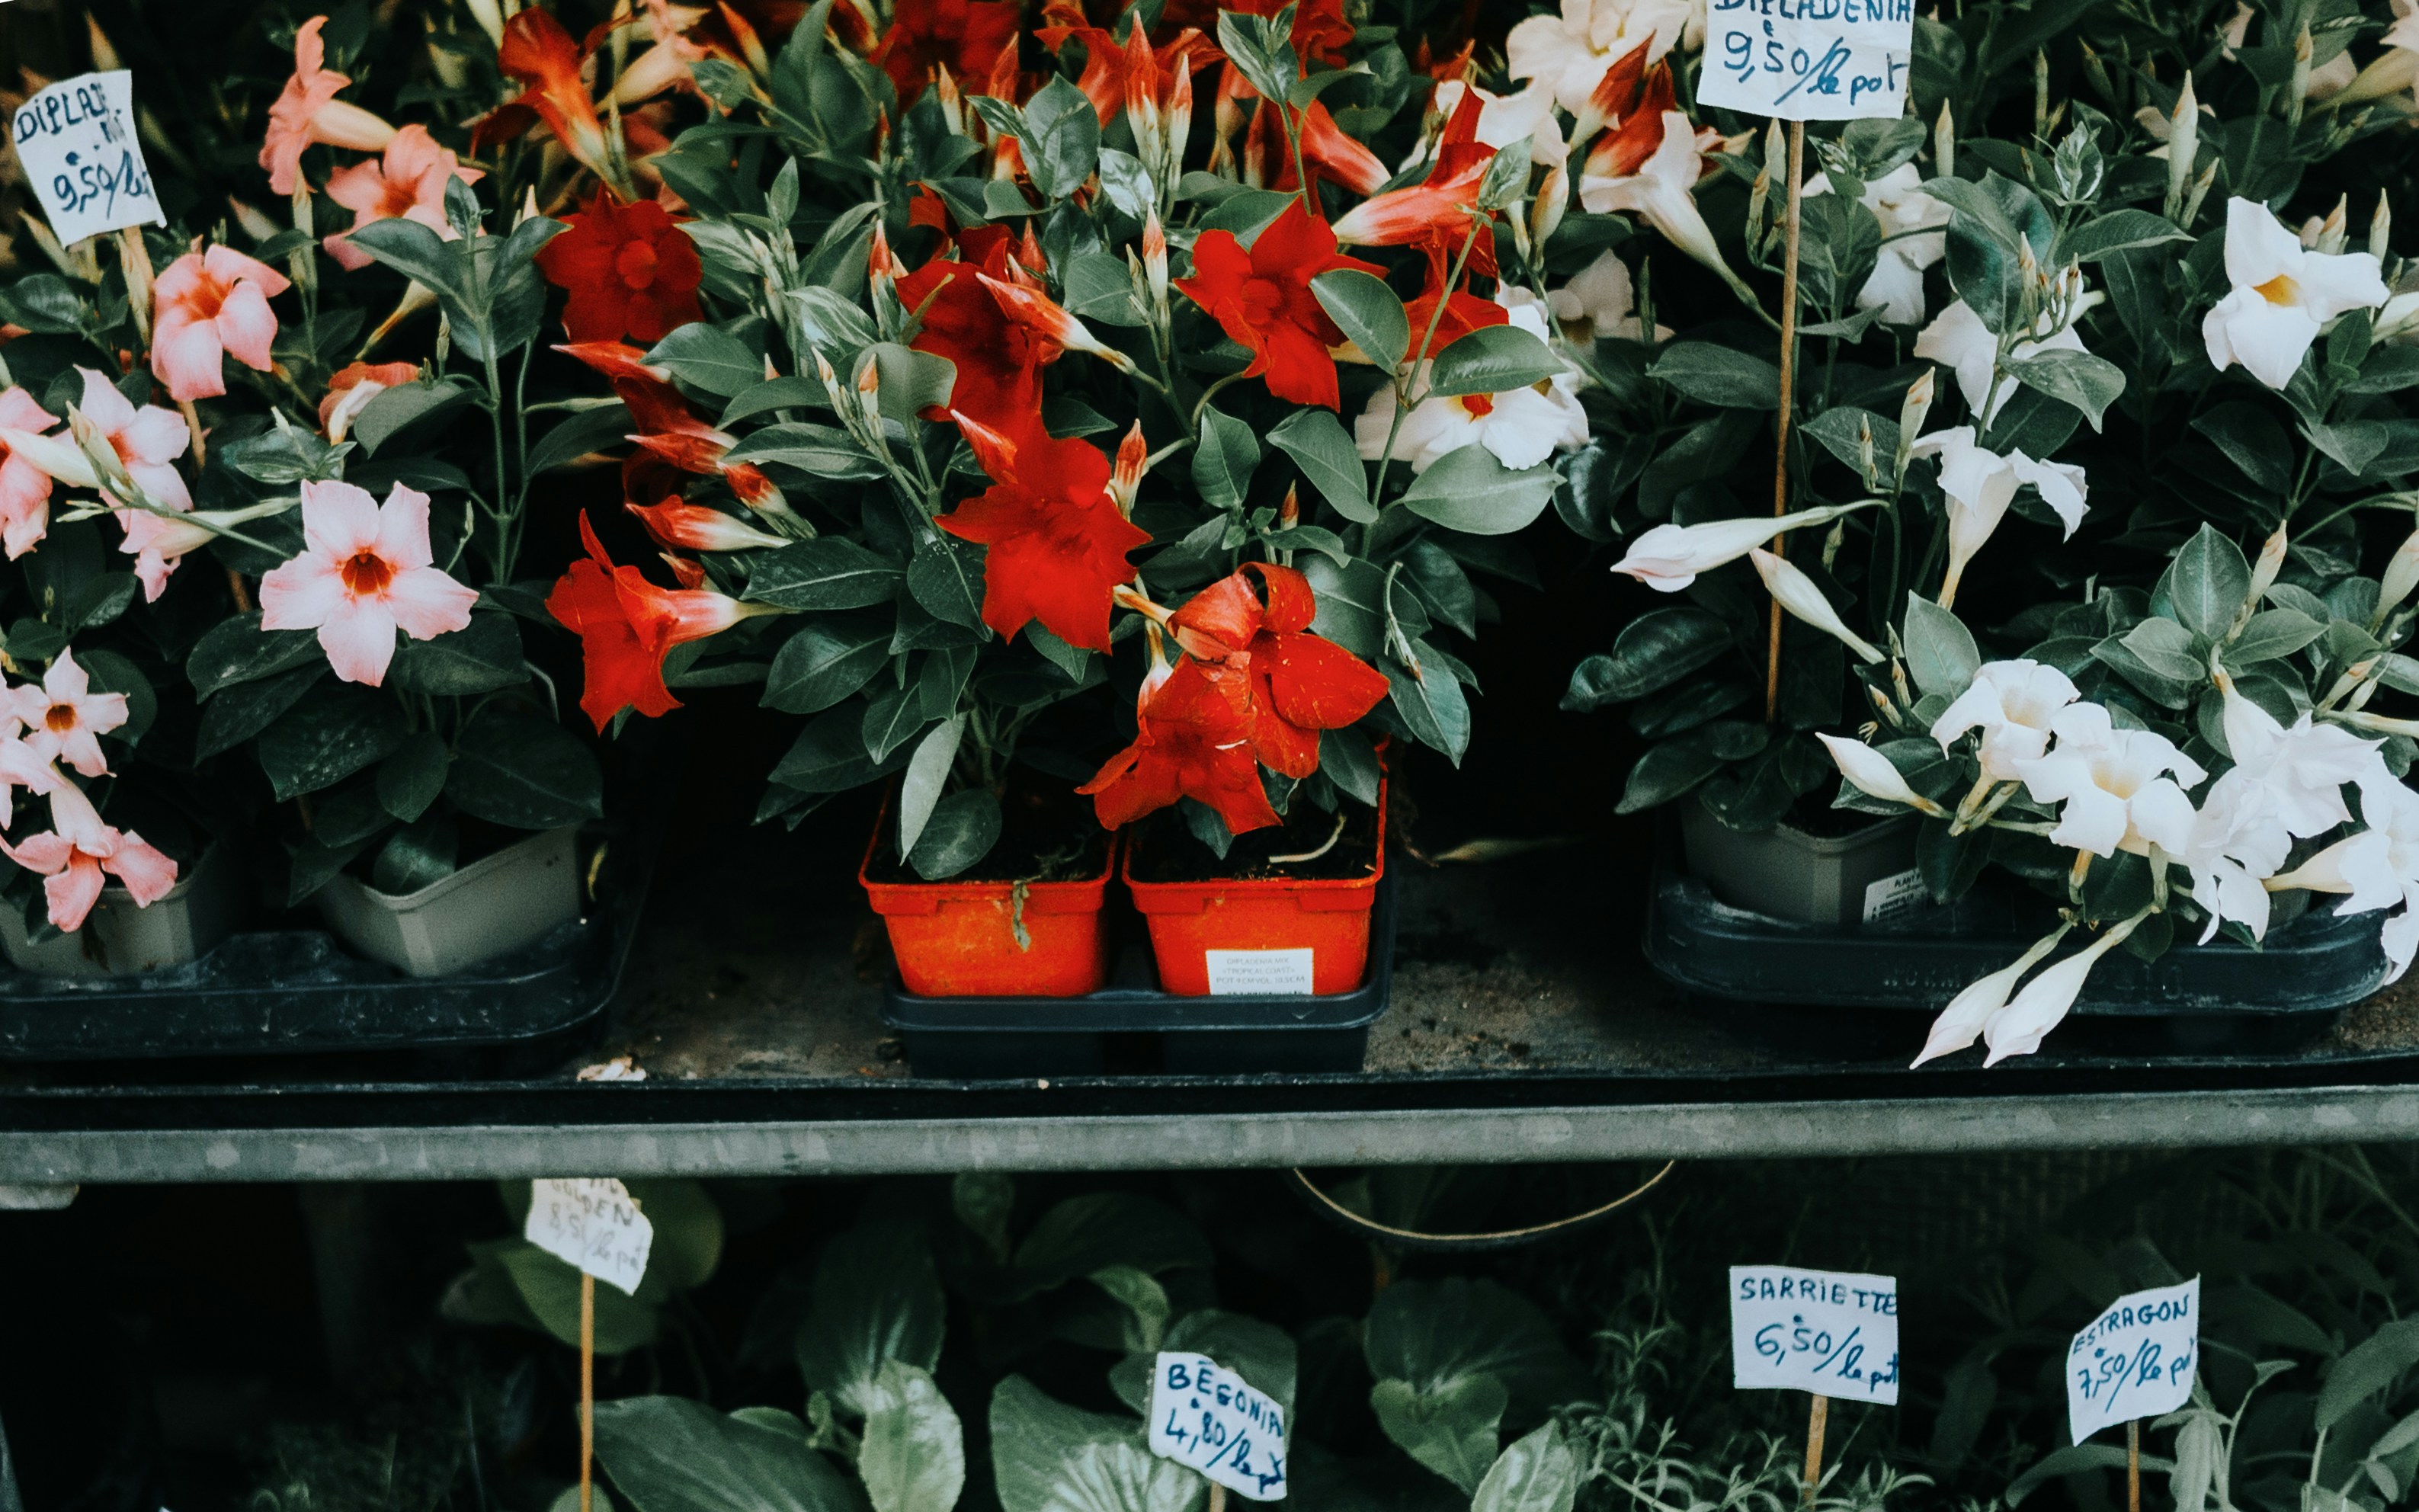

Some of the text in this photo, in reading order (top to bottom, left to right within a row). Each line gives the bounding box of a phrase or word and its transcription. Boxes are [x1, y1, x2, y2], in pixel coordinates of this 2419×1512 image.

[1850, 52, 1908, 106] pot
[1740, 1275, 1897, 1316] SARRIETTE
[2073, 1293, 2190, 1356] ESTRAGON
